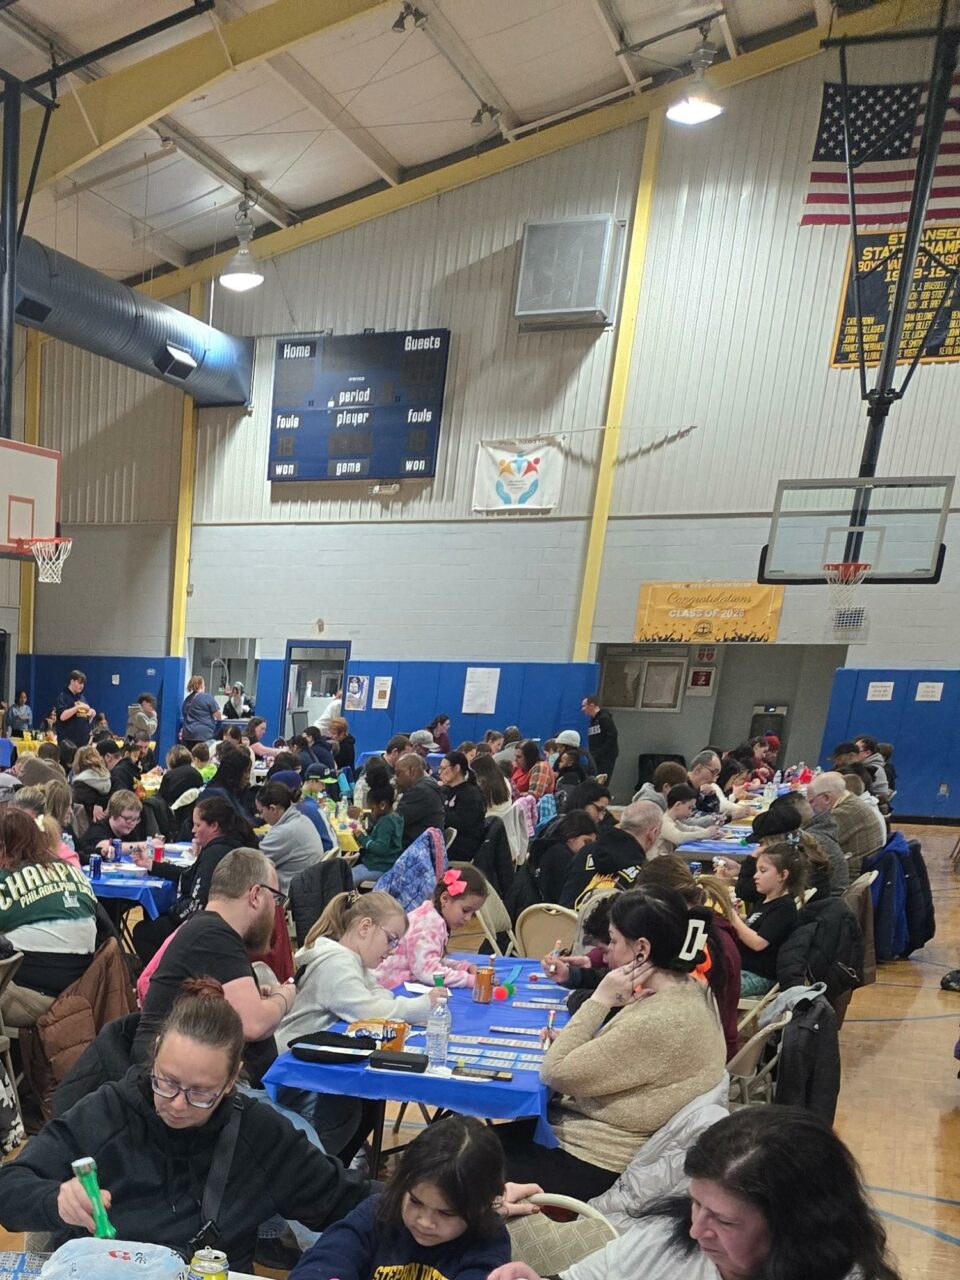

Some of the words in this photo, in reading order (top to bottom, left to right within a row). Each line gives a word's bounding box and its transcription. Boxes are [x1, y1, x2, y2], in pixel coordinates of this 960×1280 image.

[404, 335, 441, 351] Guests
[284, 344, 311, 359] Home
[339, 388, 371, 406] period
[276, 414, 300, 429] fouls
[336, 411, 370, 428] player
[407, 408, 433, 424] fouls
[275, 464, 294, 475] won
[336, 462, 361, 476] game
[405, 459, 426, 471] won
[666, 591, 752, 609] Congratulations
[669, 608, 703, 619] CLASS
[705, 608, 721, 618] OF
